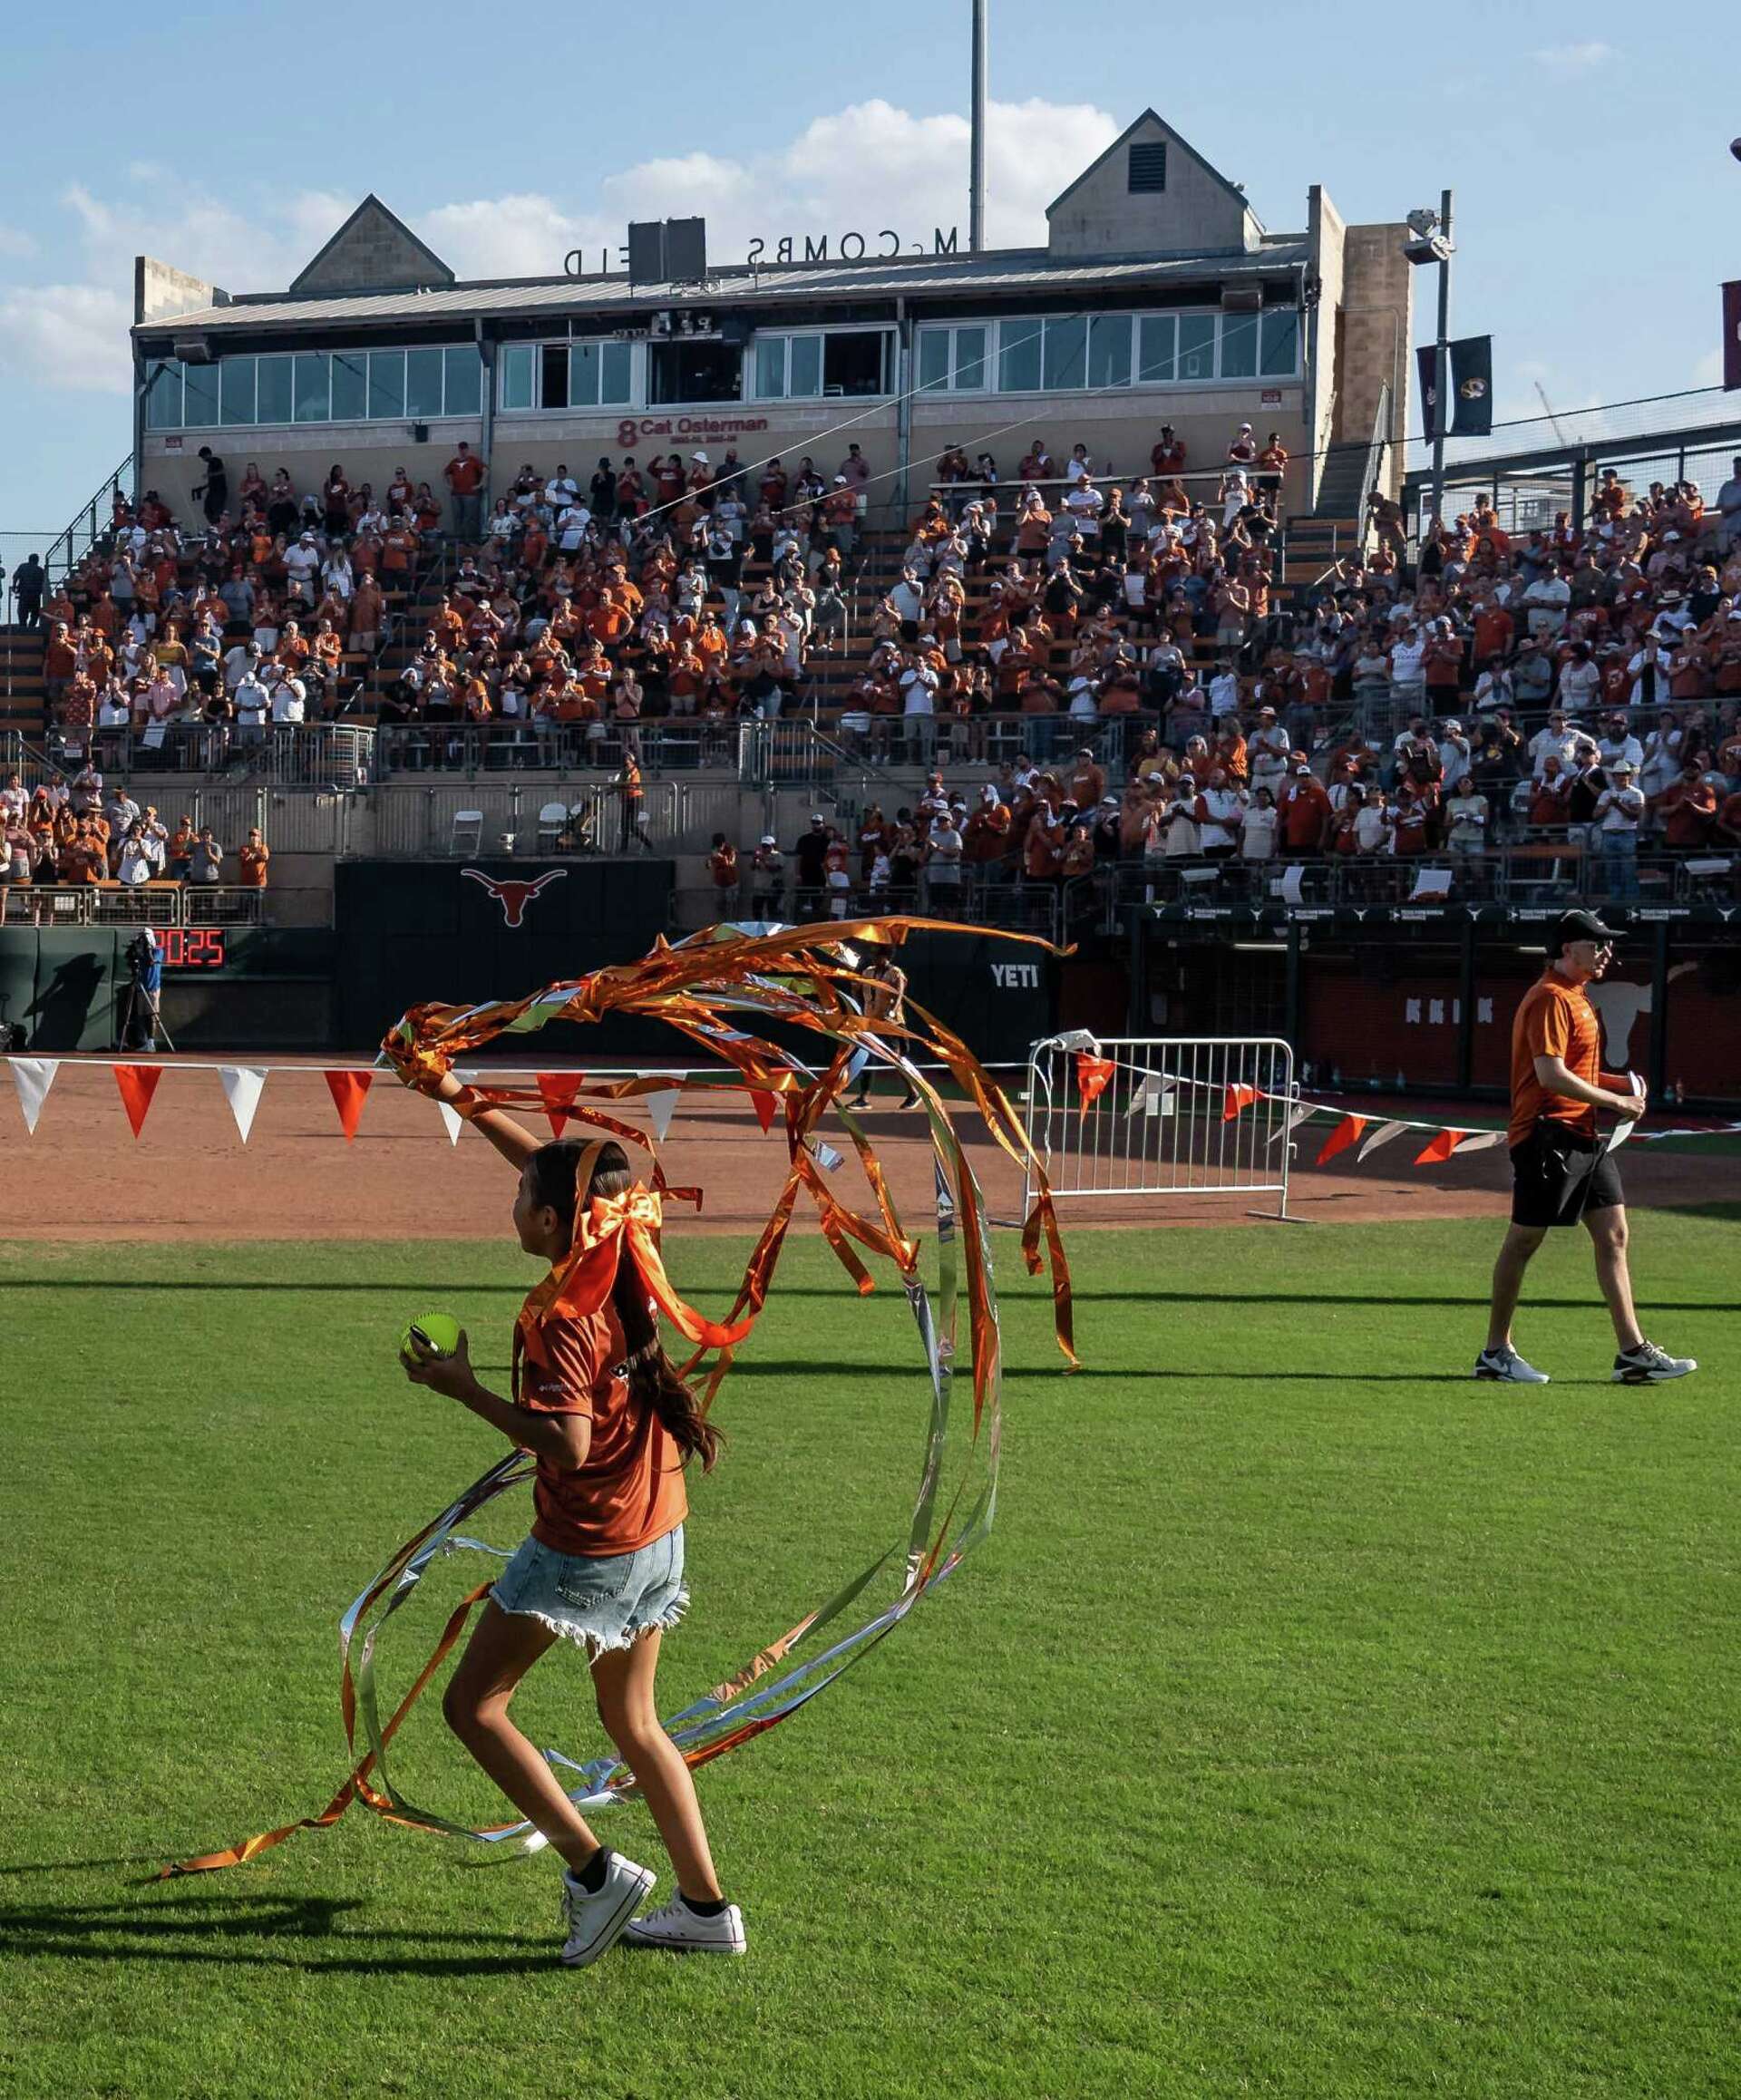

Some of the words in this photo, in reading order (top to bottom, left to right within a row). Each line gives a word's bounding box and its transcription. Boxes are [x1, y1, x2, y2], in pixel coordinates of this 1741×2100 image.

[618, 420, 638, 448] 8
[640, 419, 673, 435] Cat
[677, 417, 768, 433] Osterman
[990, 964, 1038, 987] YETI
